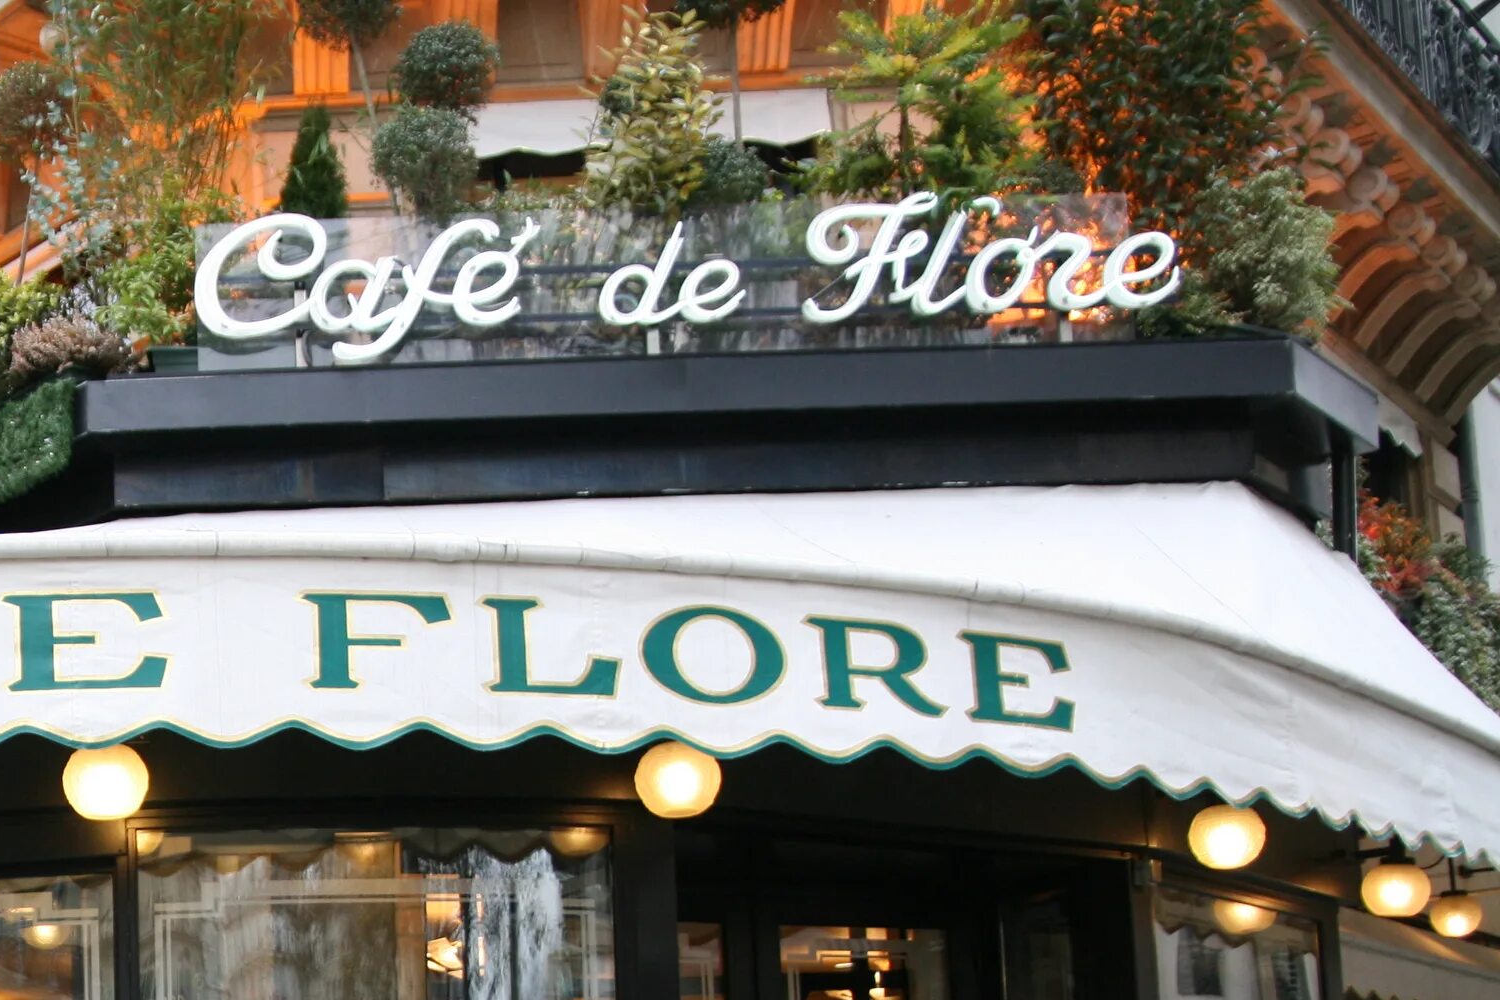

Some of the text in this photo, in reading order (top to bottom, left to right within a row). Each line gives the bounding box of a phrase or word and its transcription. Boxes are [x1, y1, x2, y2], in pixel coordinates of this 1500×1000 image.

[194, 191, 1181, 361] Café de Flore
[301, 589, 1075, 733] FLORE
